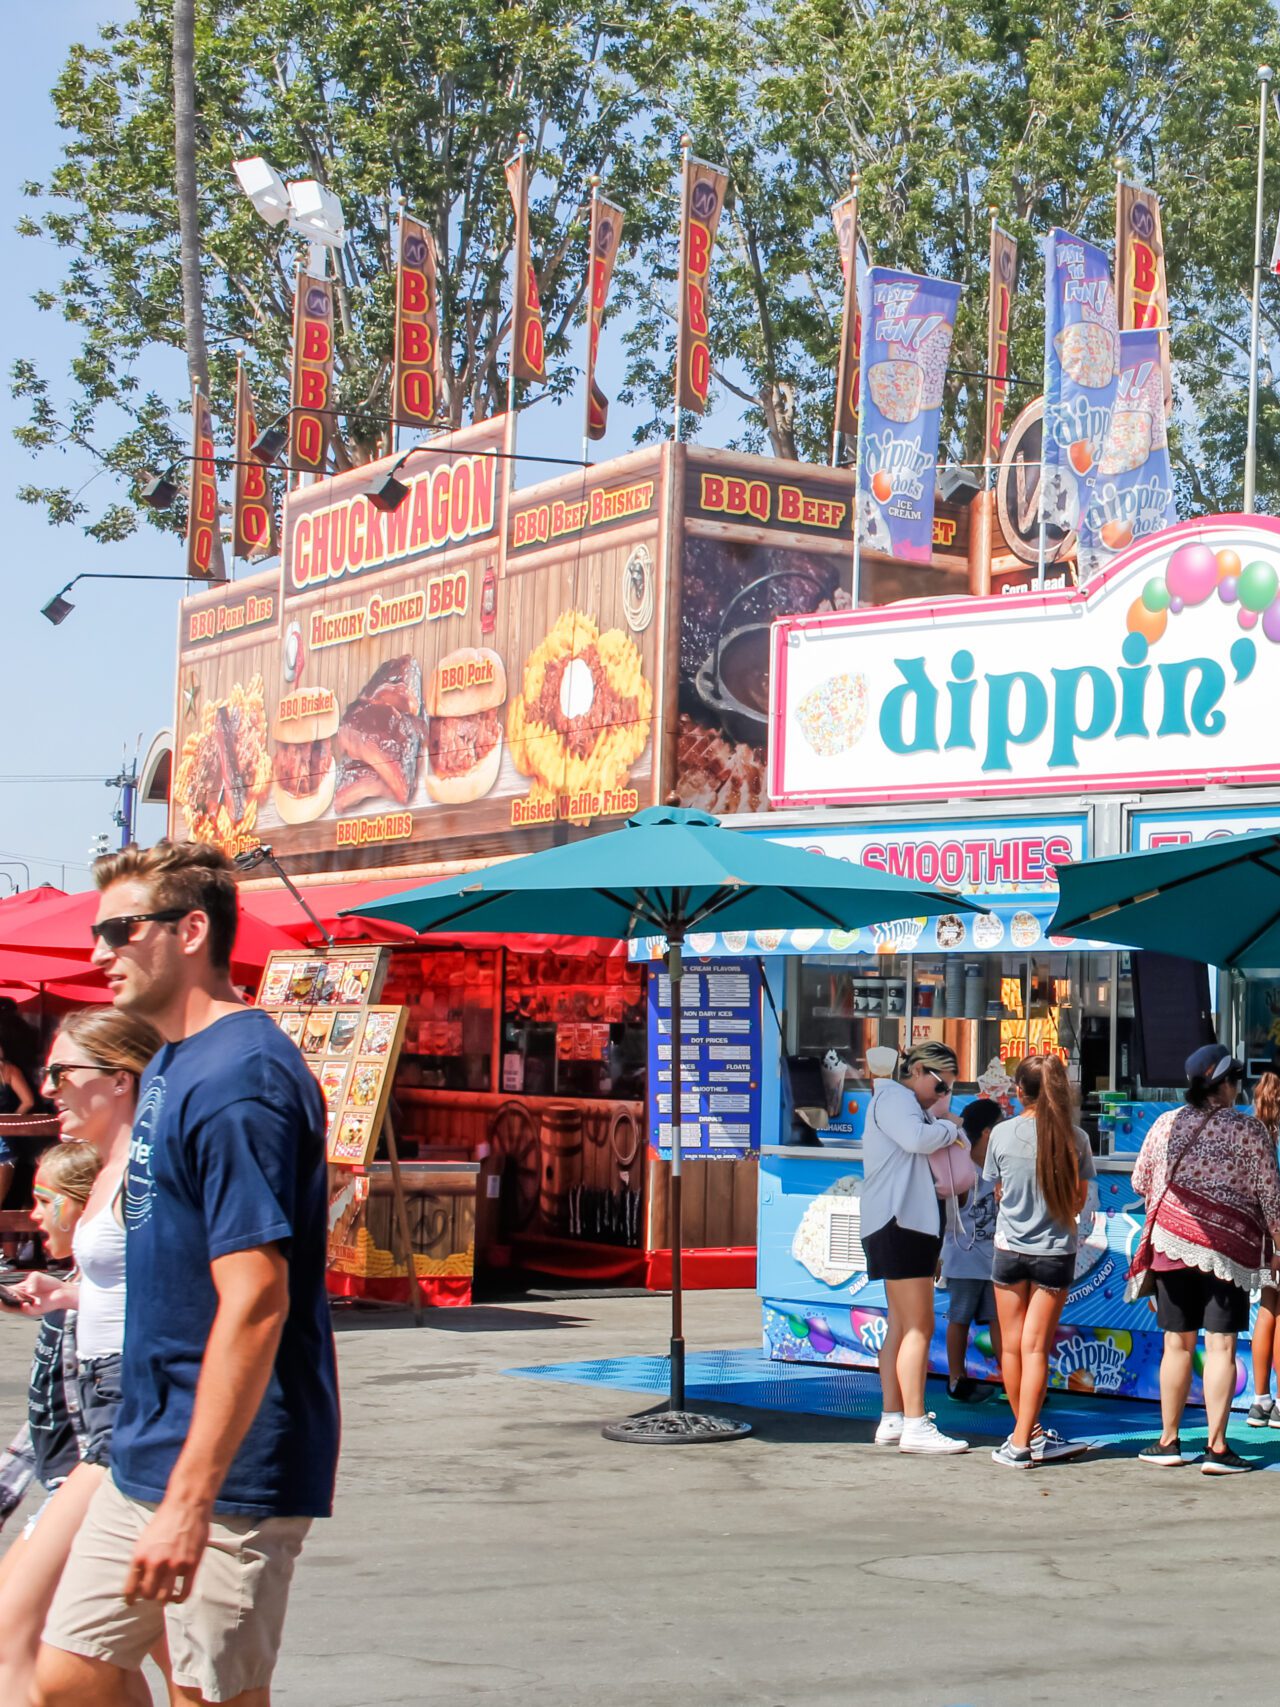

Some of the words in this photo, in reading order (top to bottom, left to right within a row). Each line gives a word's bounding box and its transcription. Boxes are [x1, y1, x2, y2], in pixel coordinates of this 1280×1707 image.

[684, 218, 712, 403] BBQ
[400, 266, 435, 420] BBQ
[874, 315, 945, 349] FUN!
[296, 318, 332, 467] BBQ
[865, 428, 935, 476] dippin'
[292, 446, 498, 589] CHUCKWAGON
[513, 506, 550, 549] BBQ
[551, 498, 590, 536] BEEF
[590, 480, 654, 525] BRISKET
[700, 472, 771, 523] BBQ
[777, 484, 846, 530] BEEF
[887, 505, 923, 521] CREAM
[896, 498, 914, 512] ICE
[1030, 573, 1067, 592] Bead
[188, 610, 216, 642] BBQ
[216, 604, 245, 635] PORK
[247, 594, 274, 628] RIBS
[309, 607, 366, 650] HICKORY
[367, 590, 426, 636] SMOKED
[427, 569, 469, 621] BBQ
[440, 663, 465, 690] BBQ
[465, 659, 494, 687] Pork
[279, 697, 300, 722] BBQ
[300, 689, 335, 717] Brisket
[877, 629, 1257, 773] dippin'
[510, 795, 558, 827] Brisket
[558, 789, 602, 823] Waffle
[602, 786, 639, 818] Fries
[336, 819, 359, 846] BBQ
[358, 815, 385, 842] Pork
[385, 812, 413, 839] RIBS
[859, 834, 1076, 888] SMOOTHIES
[725, 1063, 751, 1071] FLOATS
[1092, 1257, 1117, 1287] CANDY
[1057, 1335, 1126, 1376] dippin'
[1093, 1370, 1122, 1389] dots
